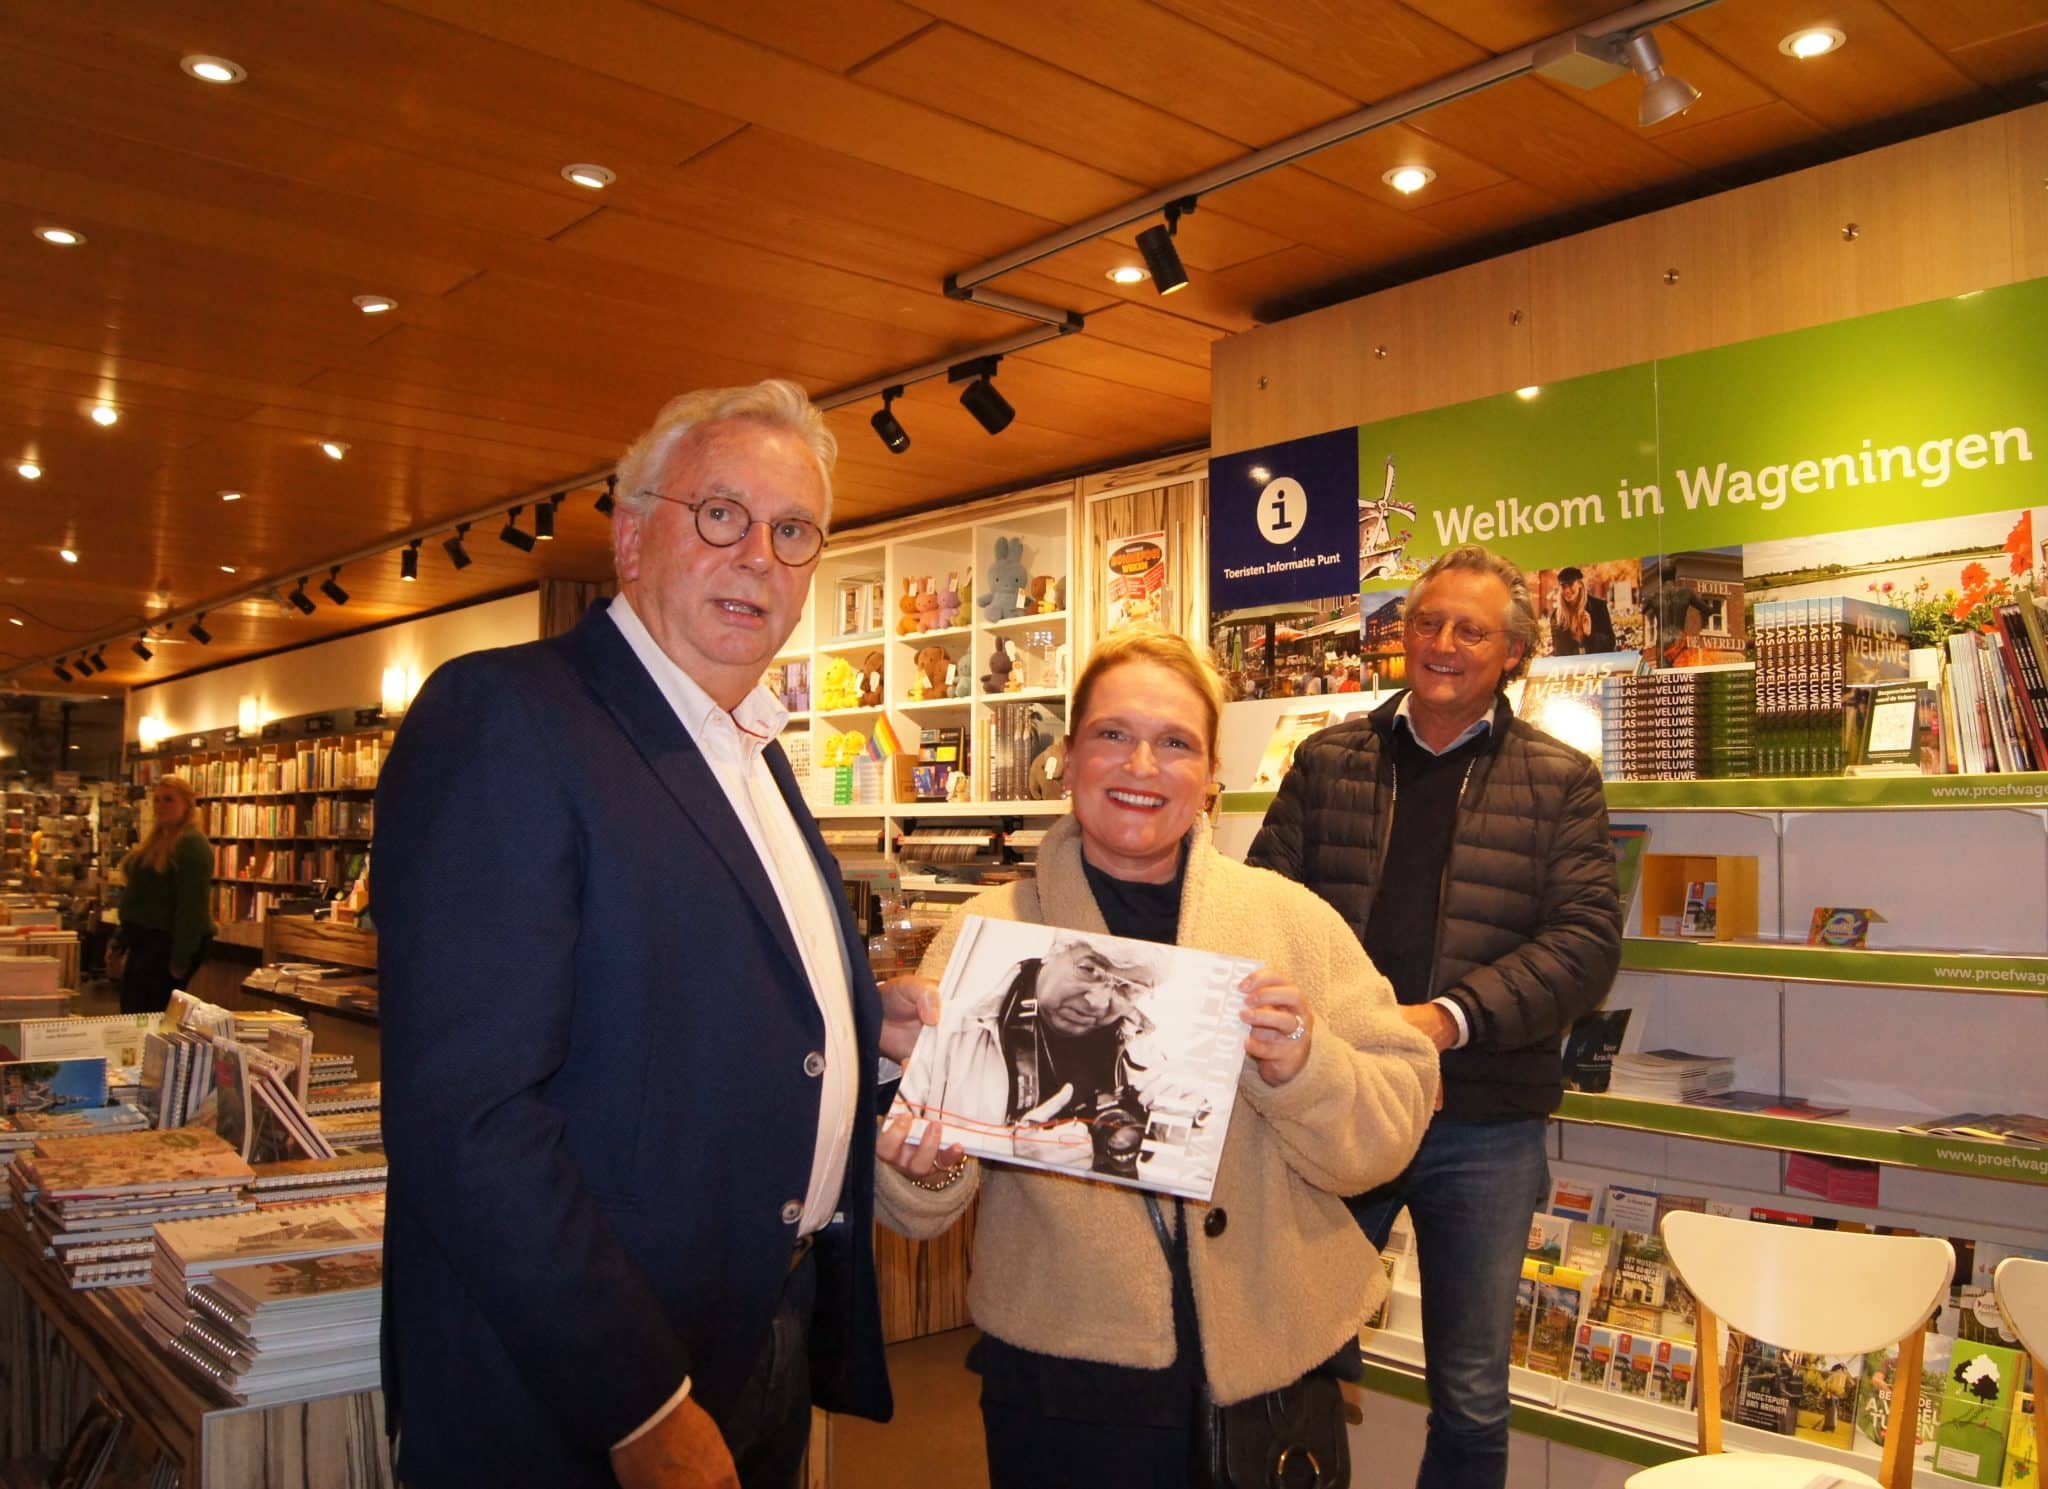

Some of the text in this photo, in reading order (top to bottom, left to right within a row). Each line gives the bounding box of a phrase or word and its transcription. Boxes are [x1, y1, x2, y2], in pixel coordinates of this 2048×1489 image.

[1432, 427, 2033, 546] Welkom in Wageningen
[1224, 552, 1341, 579] Toeristen Informatie Punt
[1697, 581, 1731, 594] HOTEL
[1856, 615, 1897, 640] ATLAS
[1702, 637, 1745, 650] WERELD
[1852, 637, 1909, 665] VELUWE
[1546, 662, 1612, 681] ATLAS
[1609, 677, 1637, 686] ATLAS
[1655, 674, 1694, 685] VELUWE
[1609, 687, 1637, 697] ATLAS
[1655, 685, 1694, 695] VELUWE
[1756, 668, 1764, 713] VELUWE
[1767, 667, 1775, 712] VELUWE
[1788, 666, 1796, 711] VELUWE
[1799, 665, 1807, 711] VELUWE
[1810, 665, 1819, 710] VELUWE
[1822, 664, 1830, 710] VELUWE
[1834, 663, 1842, 709] VELUWE
[1609, 698, 1636, 708] ATLAS
[1655, 696, 1694, 706] VELUWE
[1609, 709, 1636, 718] ATLAS
[1655, 707, 1694, 717] VELUWE
[1609, 720, 1636, 729] ATLAS
[1655, 717, 1694, 728] VELUWE
[1609, 731, 1636, 740] ATLAS
[1655, 729, 1694, 739] VELUWE
[1609, 742, 1636, 751] ATLAS
[1655, 739, 1694, 750] VELUWE
[1609, 752, 1636, 761] ATLAS
[1655, 750, 1694, 761] VELUWE
[1609, 763, 1636, 772] ATLAS
[1655, 761, 1694, 772] VELUWE
[1657, 772, 1696, 780] VELUWE
[1934, 966, 2048, 985] www.proefwag
